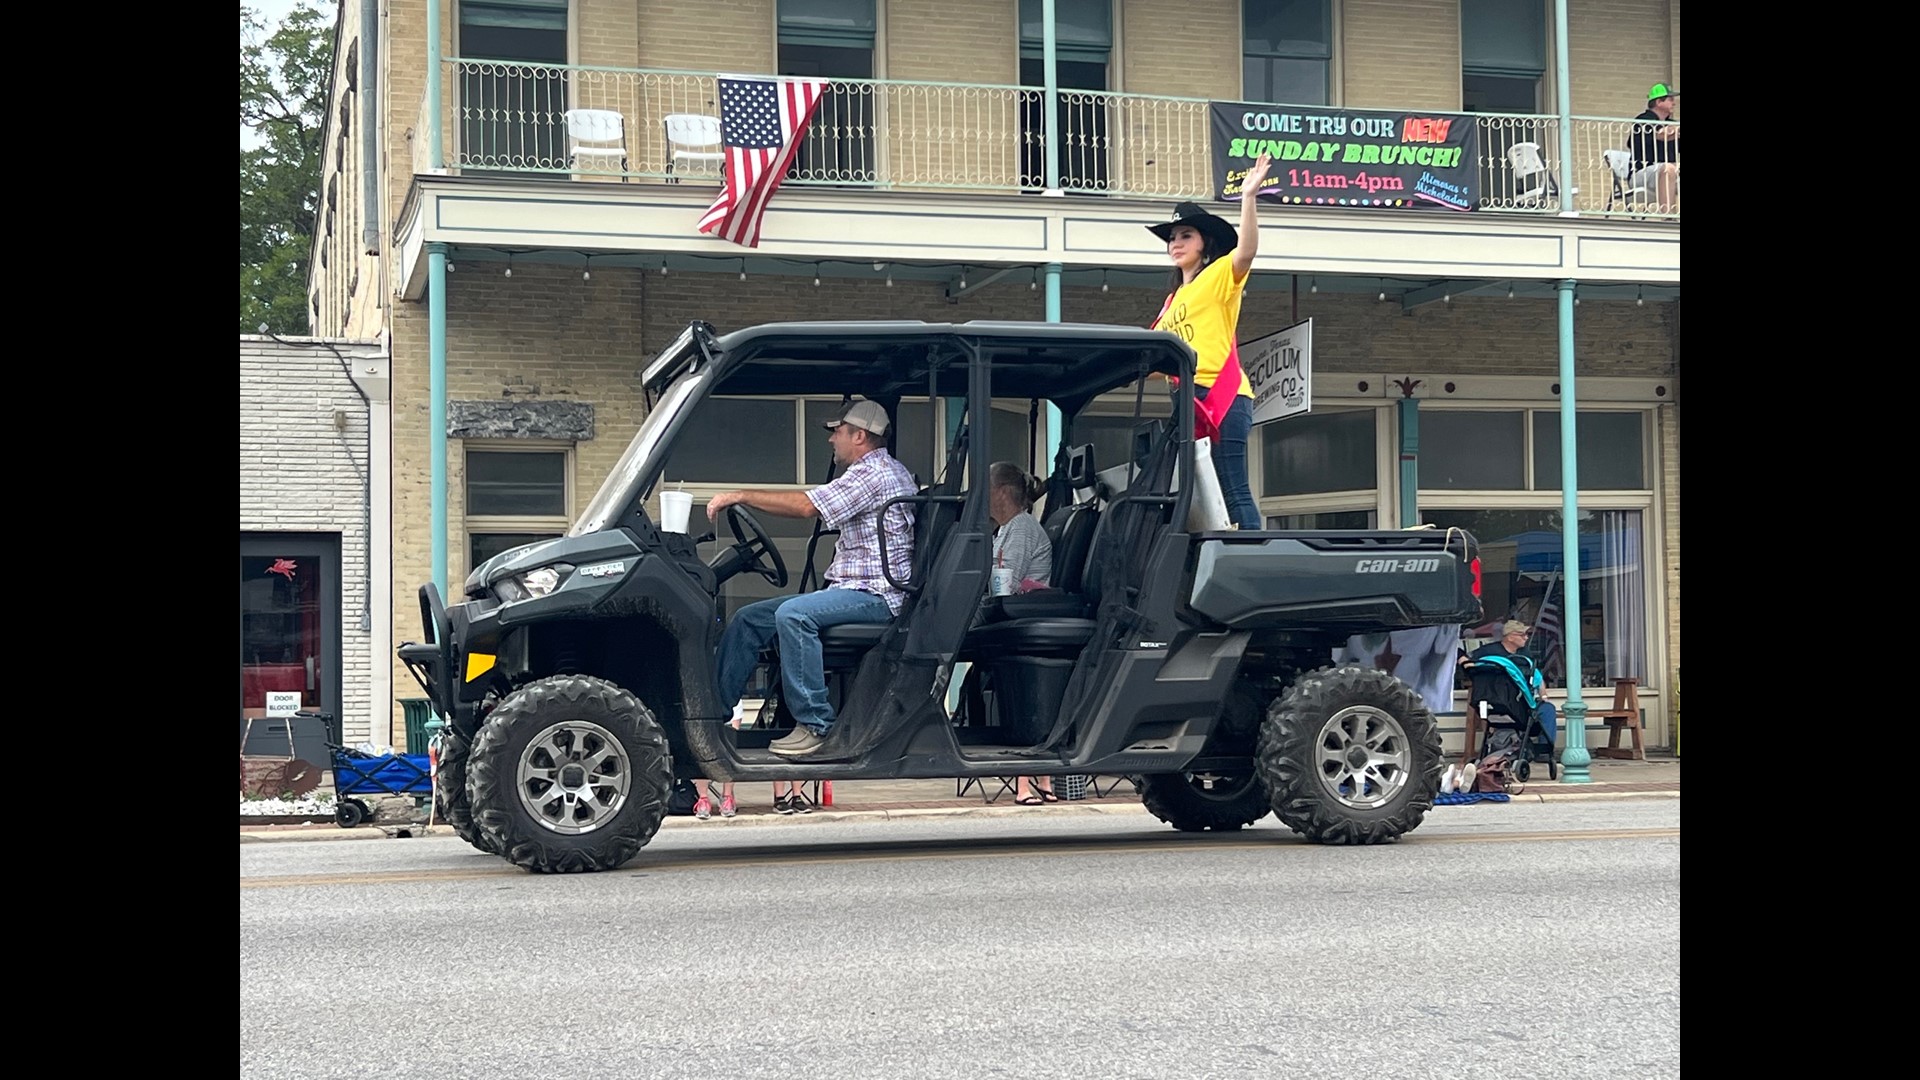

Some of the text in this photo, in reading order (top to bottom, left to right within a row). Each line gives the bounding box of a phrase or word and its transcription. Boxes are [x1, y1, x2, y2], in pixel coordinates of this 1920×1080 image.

[1242, 112, 1452, 144] COME TRY OUR NEW
[1228, 137, 1461, 168] SUNDAY BRUNCH!
[1288, 169, 1404, 194] 11am-4pm
[1414, 180, 1469, 207] Micheladas
[1420, 171, 1459, 194] Mimosas
